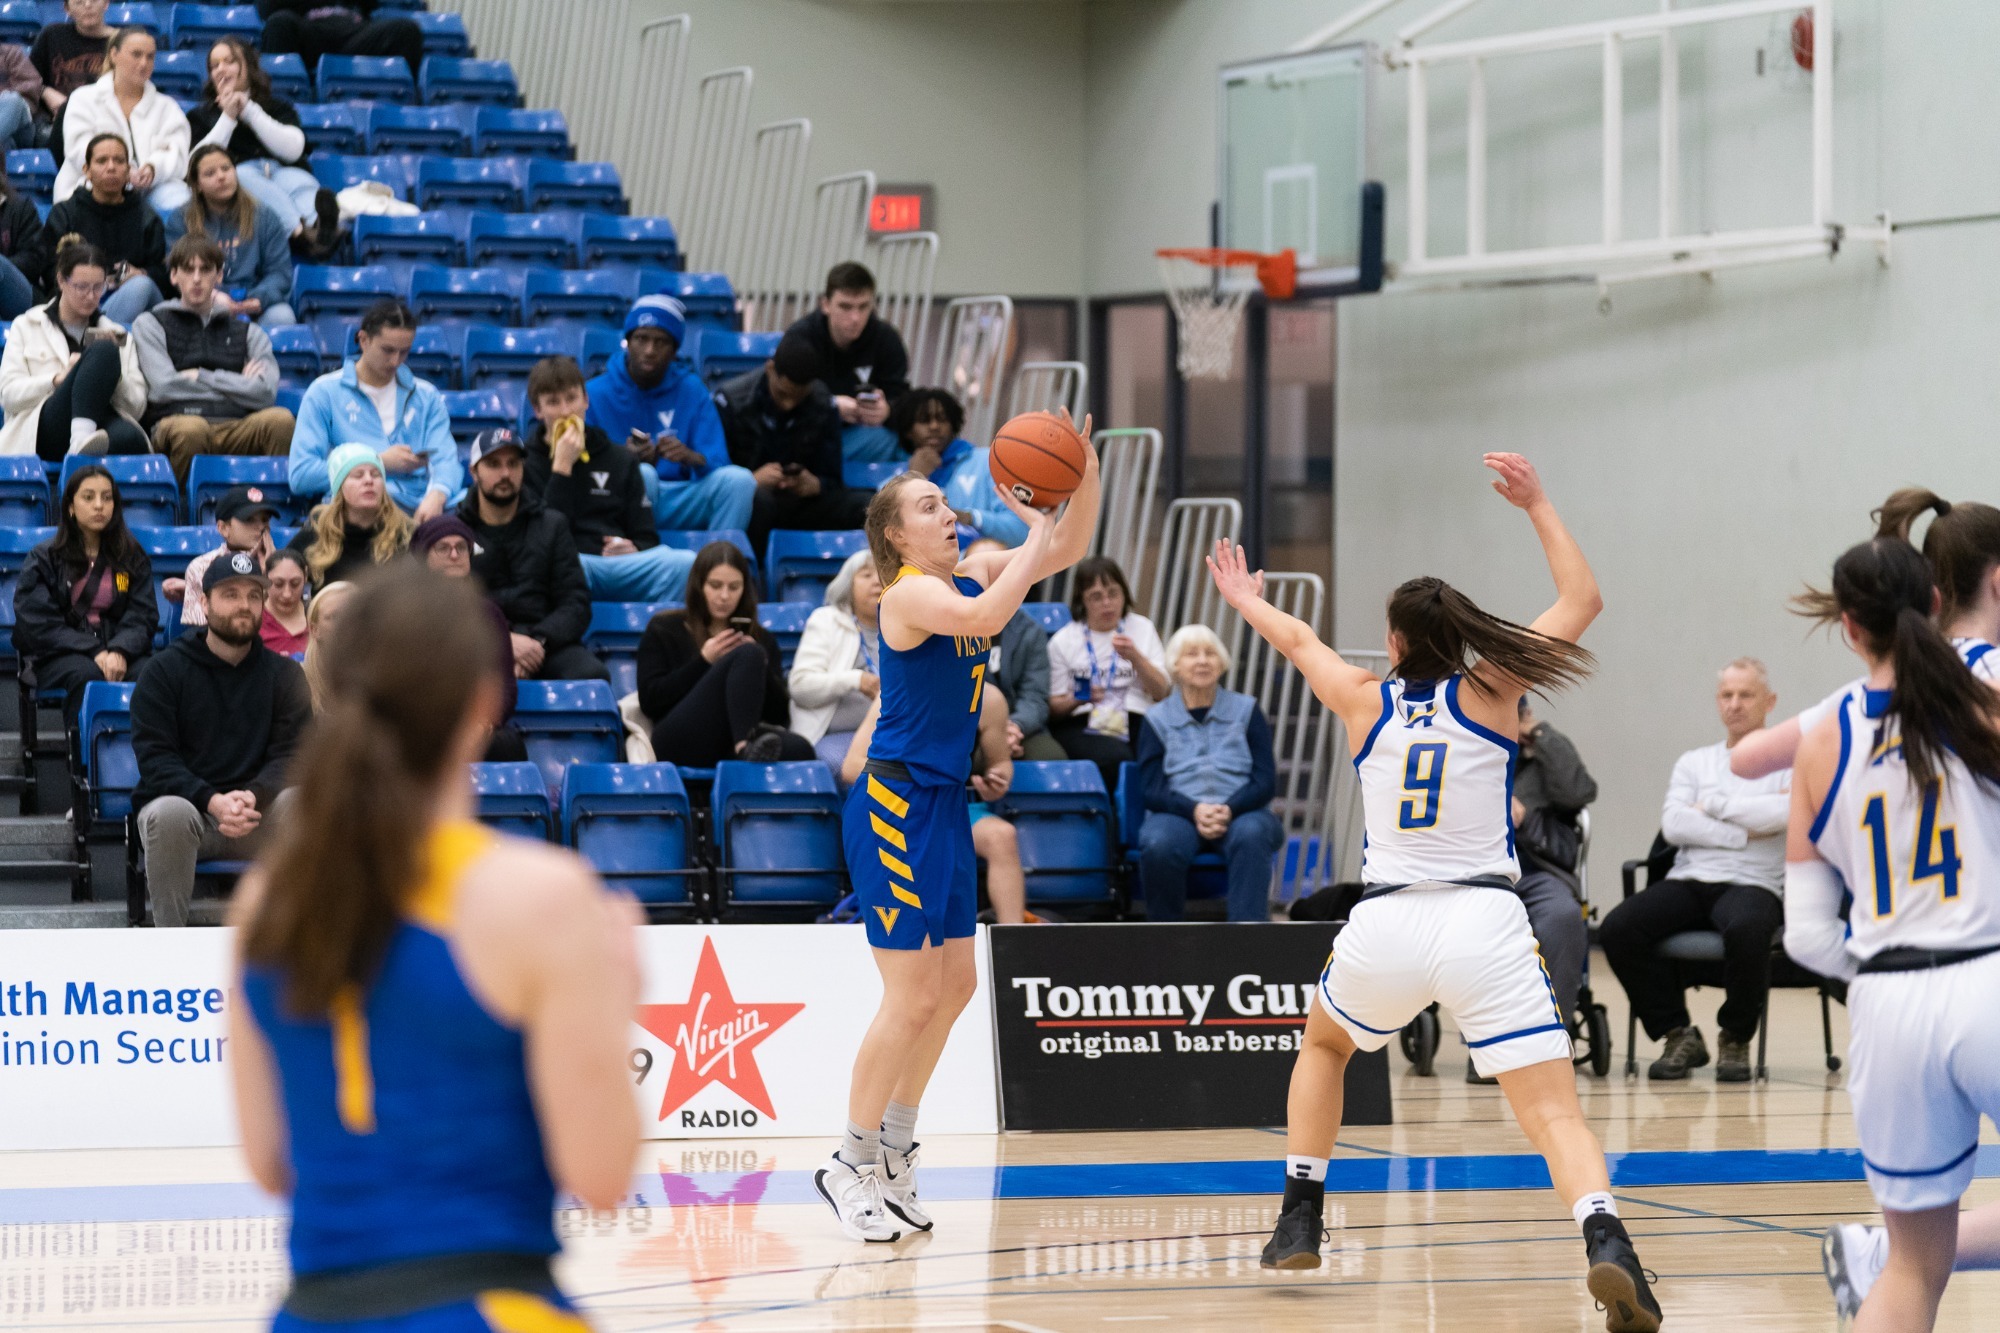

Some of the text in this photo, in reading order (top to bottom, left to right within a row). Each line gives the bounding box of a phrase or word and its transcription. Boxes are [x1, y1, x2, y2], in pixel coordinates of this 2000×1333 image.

[969, 663, 986, 713] 7
[1397, 740, 1450, 832] 9
[1859, 771, 1963, 922] 14
[64, 981, 235, 1023] Manage
[1011, 976, 1215, 1026] Tommy
[117, 1030, 229, 1065] Secur
[675, 991, 769, 1079] Virgin
[1040, 1031, 1162, 1060] original
[681, 1109, 758, 1129] RADIO
